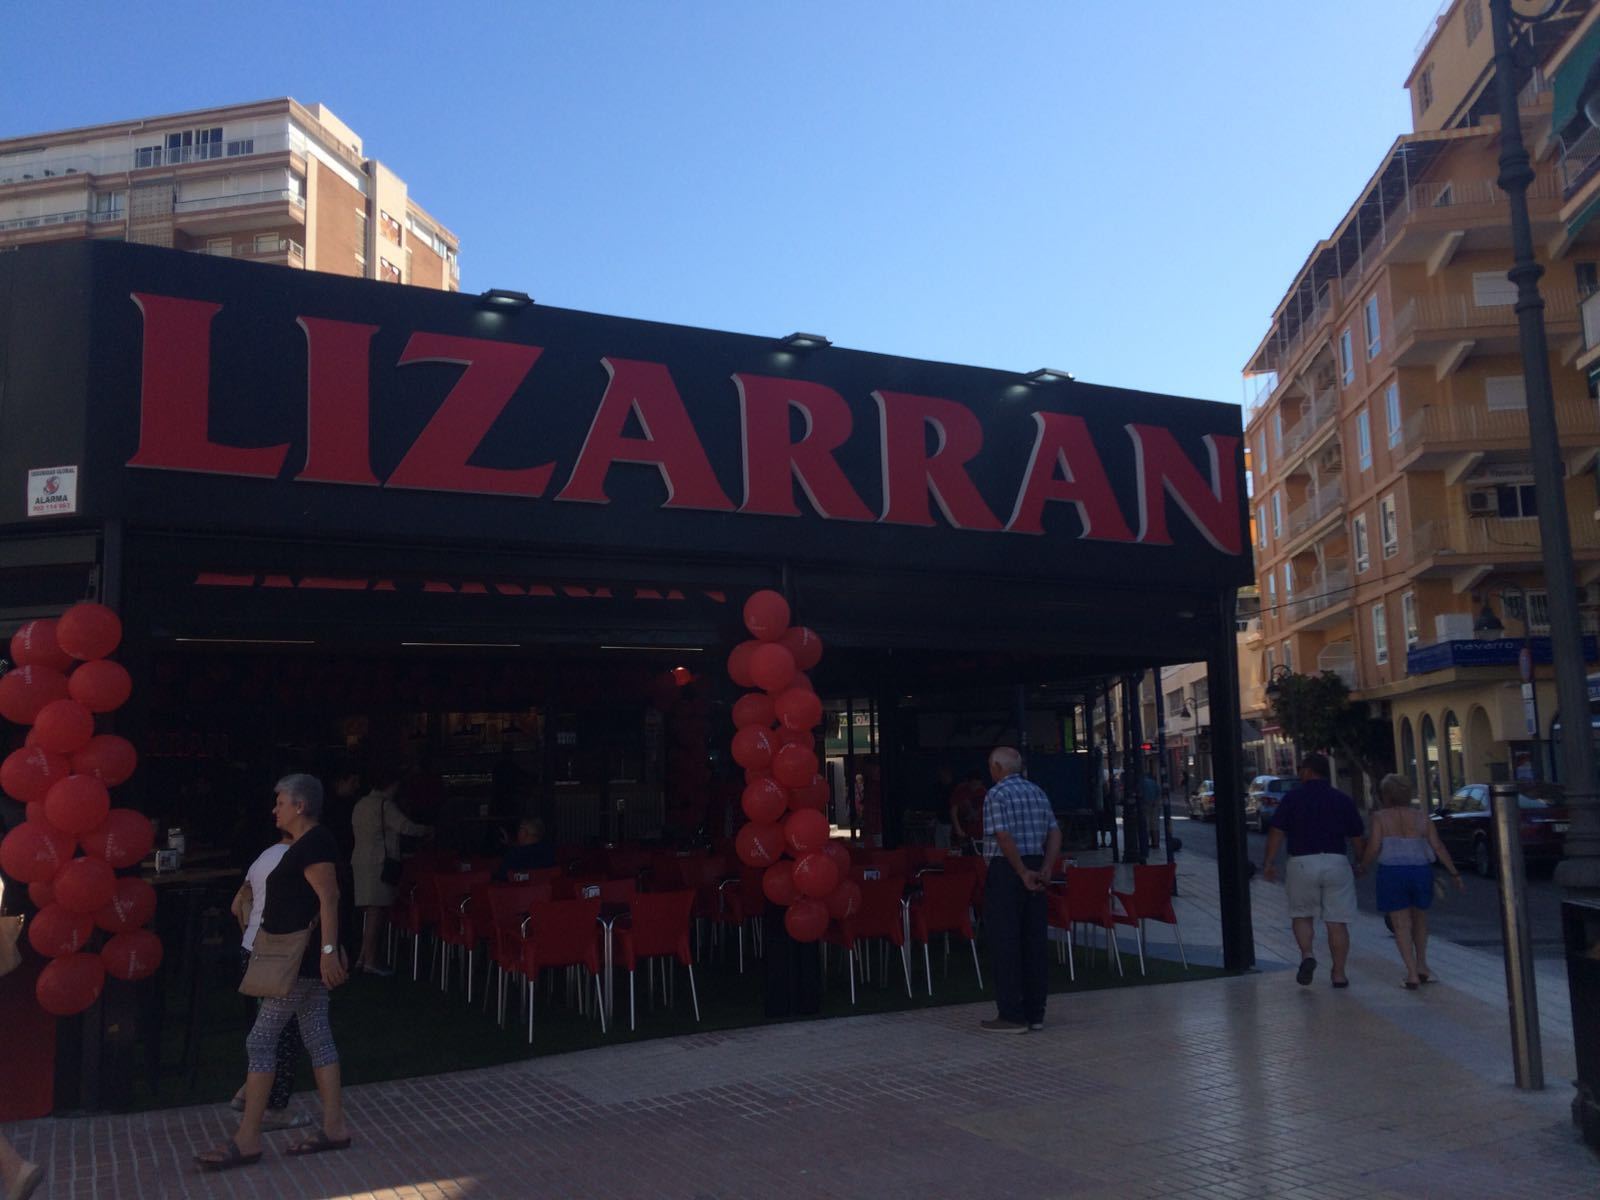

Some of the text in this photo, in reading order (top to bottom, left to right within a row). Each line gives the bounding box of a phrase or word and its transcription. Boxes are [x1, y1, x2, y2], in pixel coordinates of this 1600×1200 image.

[125, 291, 1243, 556] LIZARRAN
[35, 495, 68, 504] ALARMA
[1453, 641, 1514, 651] navarro
